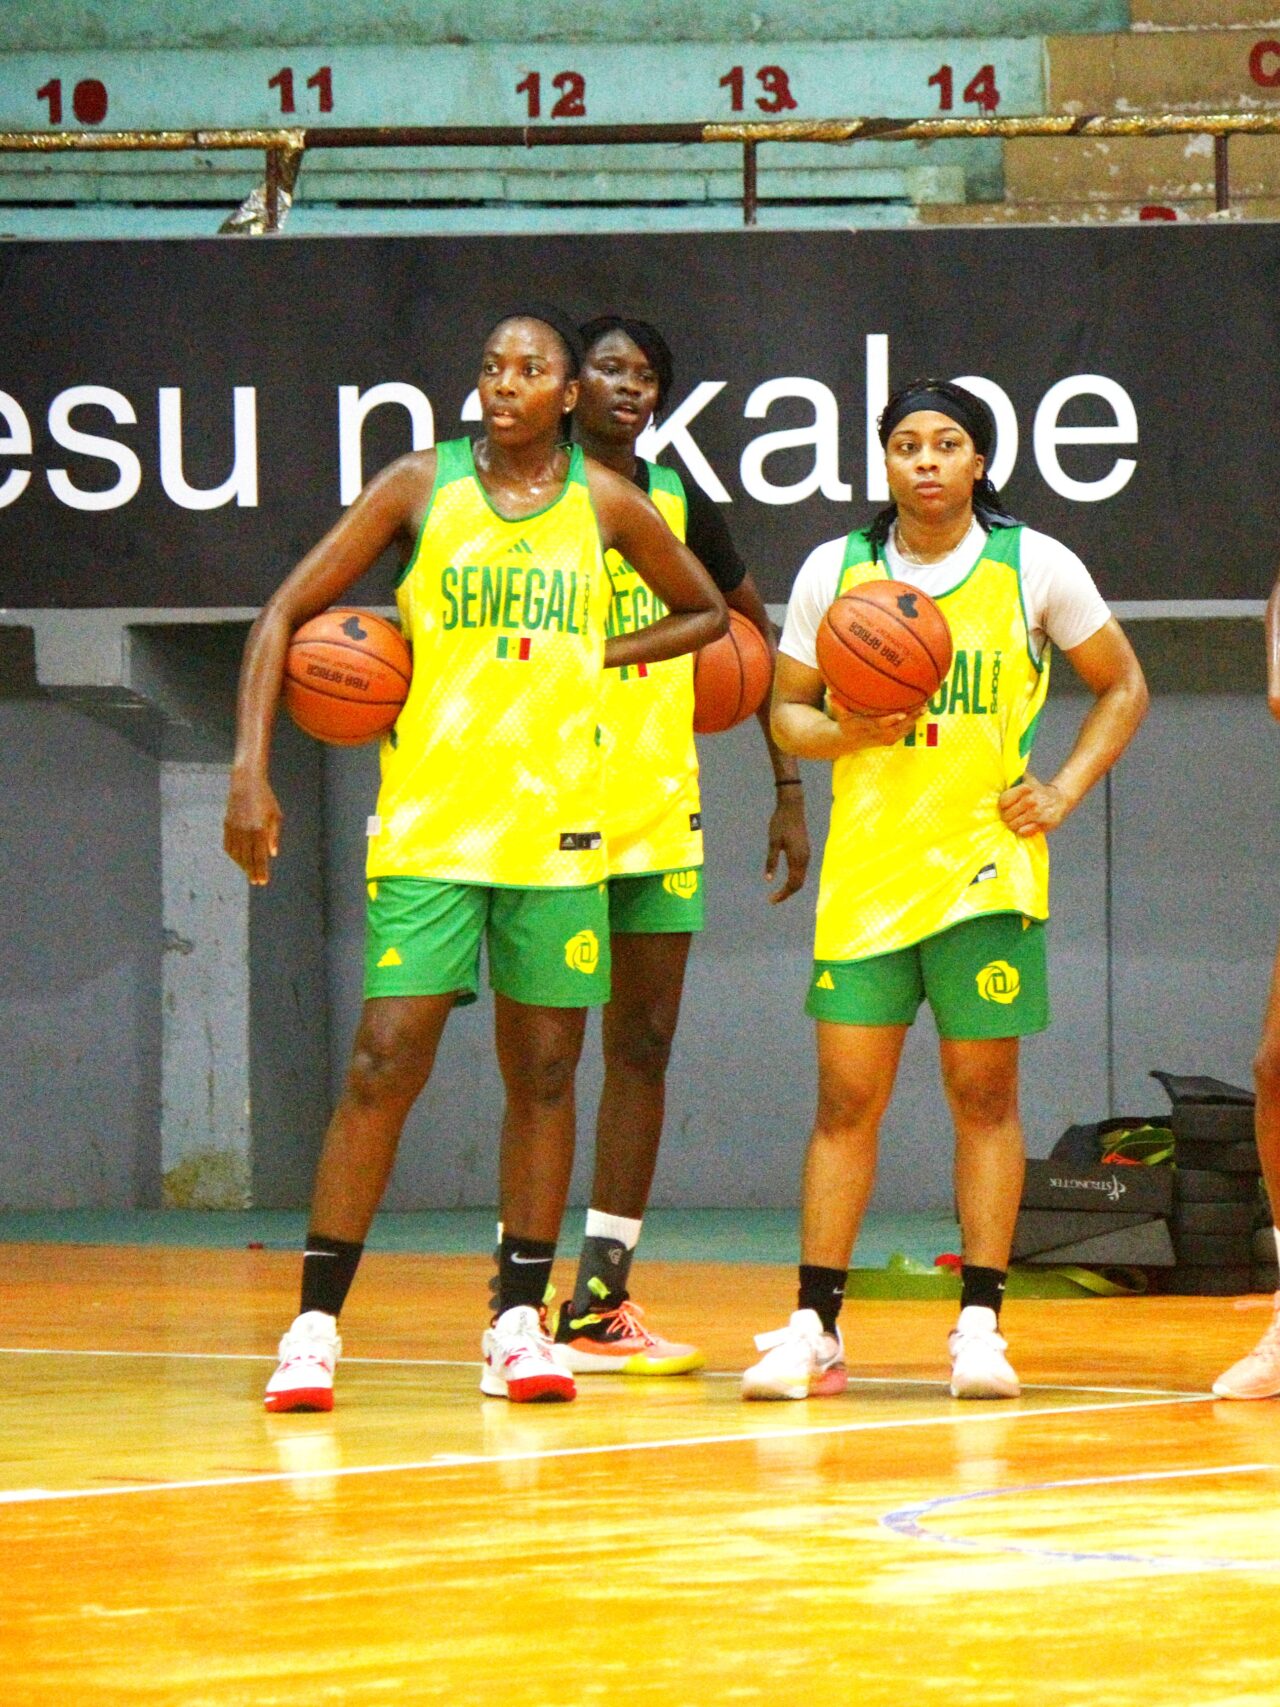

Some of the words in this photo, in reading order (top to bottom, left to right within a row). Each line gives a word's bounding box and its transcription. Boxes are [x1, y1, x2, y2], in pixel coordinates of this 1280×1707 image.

[36, 79, 108, 125] 10
[269, 67, 333, 113] 11
[517, 71, 586, 118] 12
[719, 65, 796, 113] 13
[927, 65, 1000, 110] 14
[338, 381, 482, 506] n
[441, 566, 579, 634] SENEGAL
